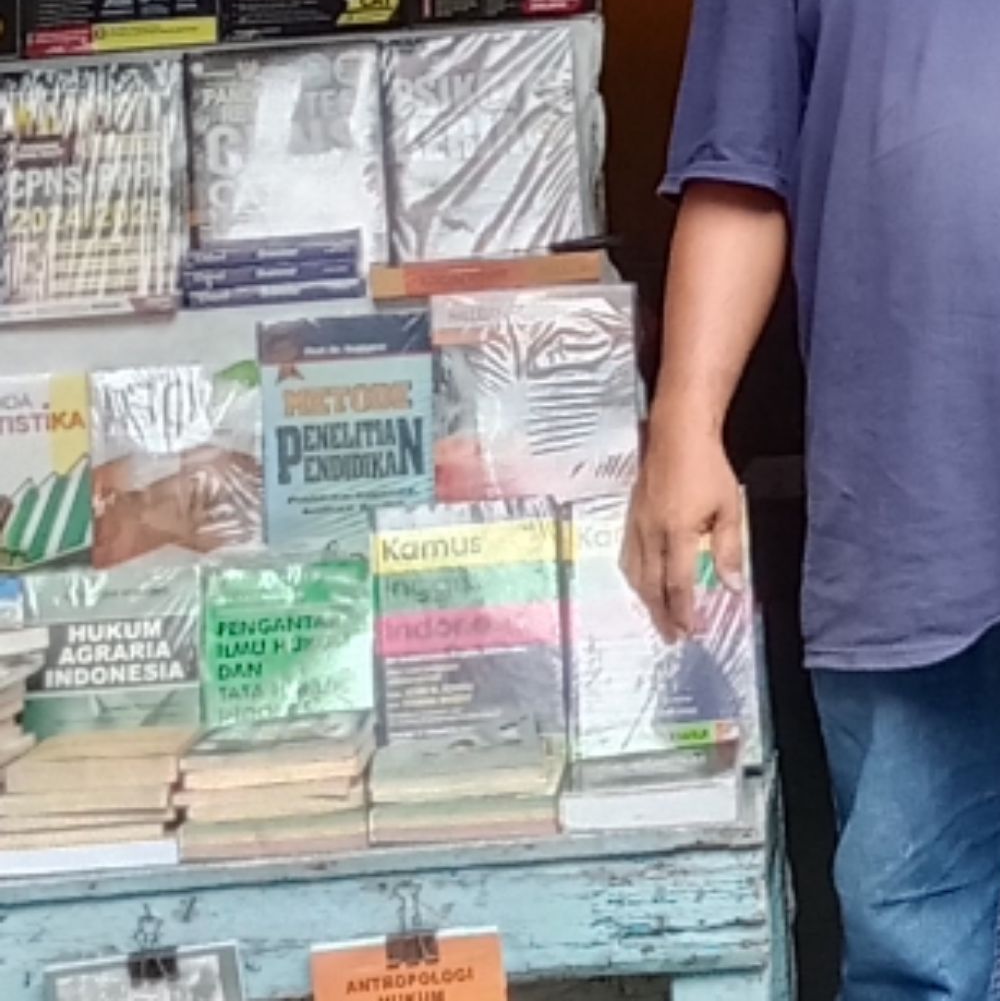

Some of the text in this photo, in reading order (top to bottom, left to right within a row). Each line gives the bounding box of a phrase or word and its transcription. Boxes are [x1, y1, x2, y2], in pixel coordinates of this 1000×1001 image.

[381, 536, 482, 563] Kamus
[67, 618, 164, 644] HUKUM
[57, 640, 171, 666] AGRARIA
[44, 662, 186, 689] INDONESIA
[217, 661, 264, 682] DAN
[344, 966, 475, 995] ANTROPOLOGI
